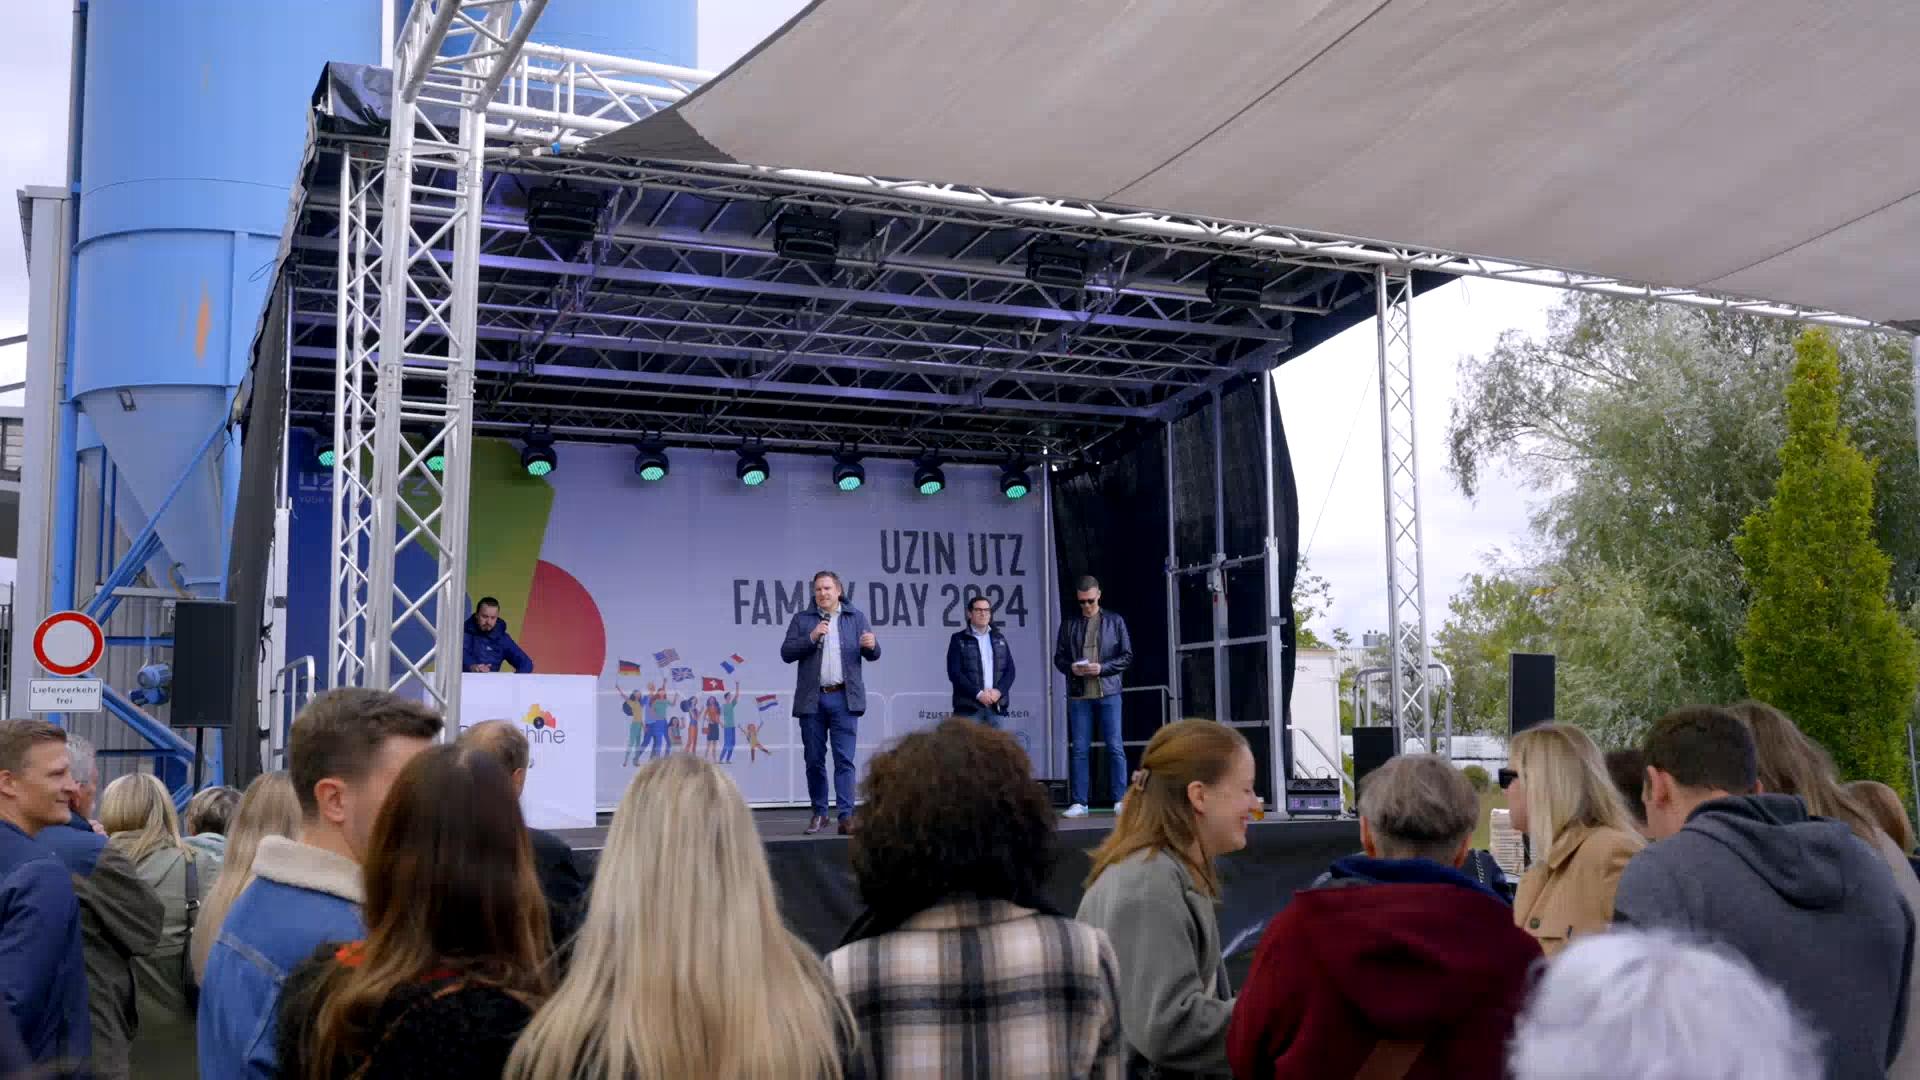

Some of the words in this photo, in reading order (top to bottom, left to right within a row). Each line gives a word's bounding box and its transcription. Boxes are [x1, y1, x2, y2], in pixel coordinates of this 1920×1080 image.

[880, 529, 956, 576] UZIN
[967, 532, 1026, 577] UTZ
[733, 579, 856, 626] FAM
[868, 581, 929, 627] DAY
[32, 686, 98, 694] Lieferverkehr
[56, 697, 73, 705] frei
